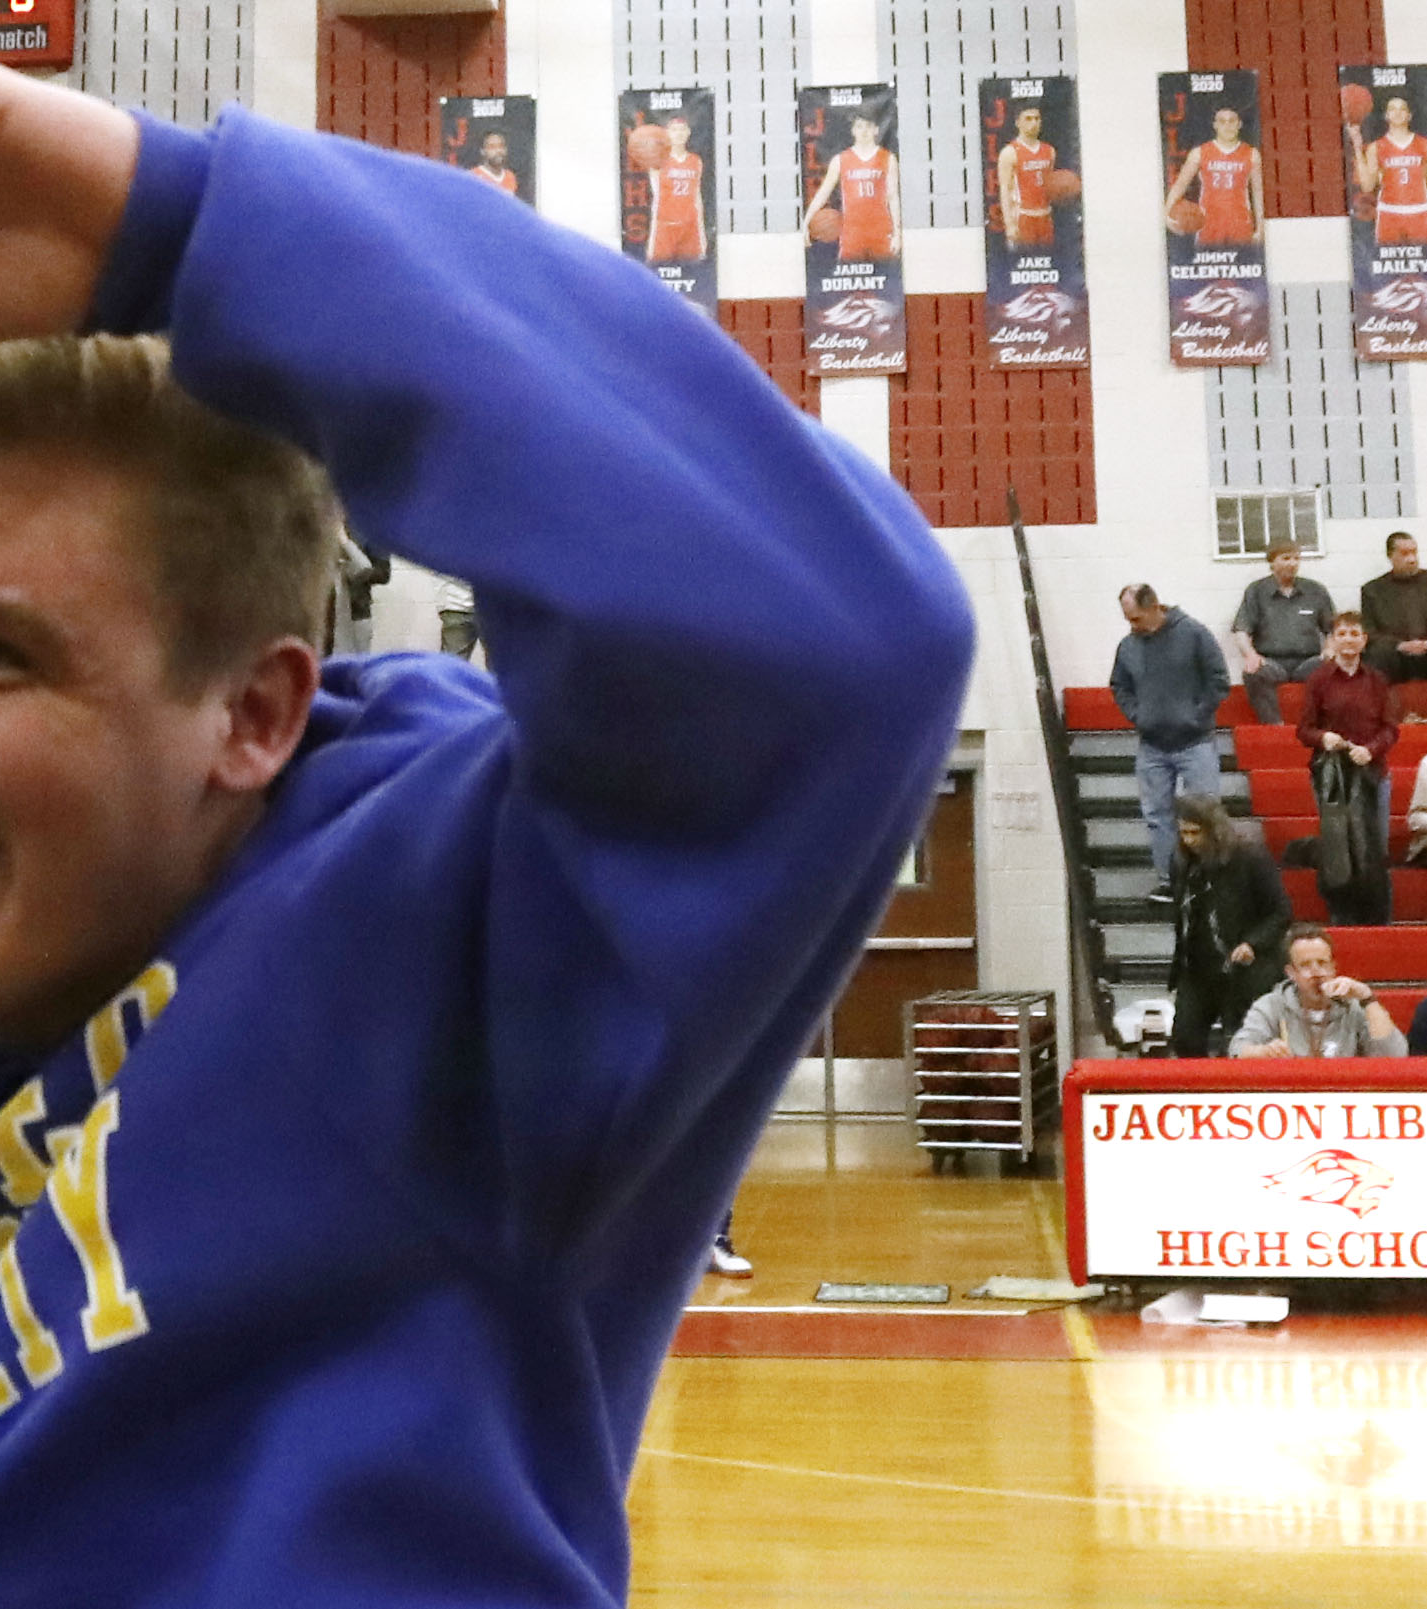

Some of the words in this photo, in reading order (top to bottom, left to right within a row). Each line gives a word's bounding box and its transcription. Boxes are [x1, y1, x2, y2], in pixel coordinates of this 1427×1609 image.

[1011, 86, 1044, 98] 2020
[1191, 81, 1225, 92] 2020
[1193, 252, 1238, 264] JIMMY
[1379, 246, 1423, 259] BRYCE
[833, 264, 874, 276] JARED
[1017, 257, 1051, 269] JAKE
[657, 266, 682, 279] TIM
[1010, 270, 1059, 285] BOSCO
[1170, 264, 1262, 279] CELENTANO
[821, 276, 887, 292] DURANT
[1172, 320, 1232, 340] Liberty
[1359, 315, 1419, 335] Liberty
[809, 332, 869, 352] Liberty
[989, 326, 1050, 345] Liberty
[999, 345, 1087, 364] Basketball
[1180, 340, 1269, 359] Basketball
[819, 351, 905, 370] Basketball
[1093, 1102, 1326, 1142] JACKSON
[1341, 1103, 1426, 1141] LIB
[1156, 1230, 1290, 1268] HIGH
